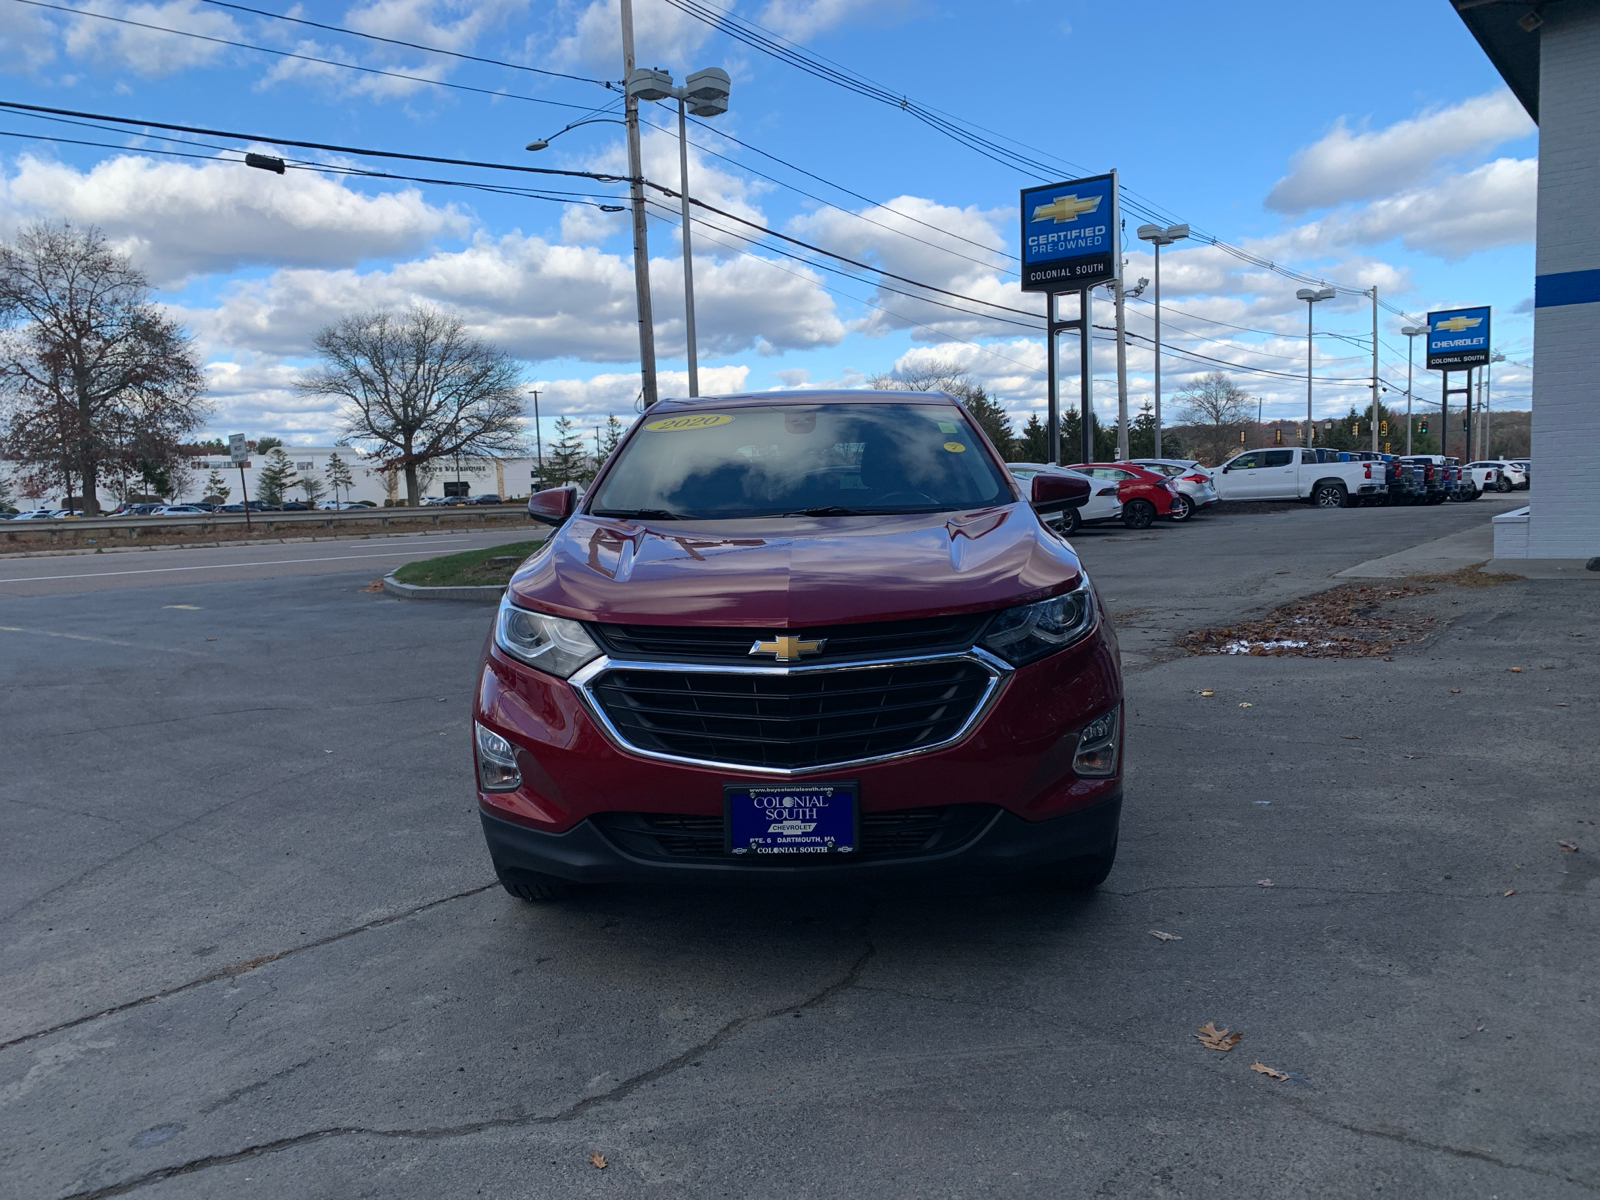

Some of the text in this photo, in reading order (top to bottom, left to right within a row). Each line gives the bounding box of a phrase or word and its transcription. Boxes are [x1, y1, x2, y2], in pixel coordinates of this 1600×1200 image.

[1028, 225, 1106, 246] CERTIFIED
[1032, 236, 1102, 255] PRE-OWNED
[1030, 263, 1104, 281] COLONIAL SOUTH
[1431, 337, 1485, 349] CHEVROLET
[1431, 357, 1461, 365] COLONIAL
[660, 416, 720, 430] 2020
[754, 796, 829, 809] COLONIAL
[766, 808, 817, 820] SOUTH
